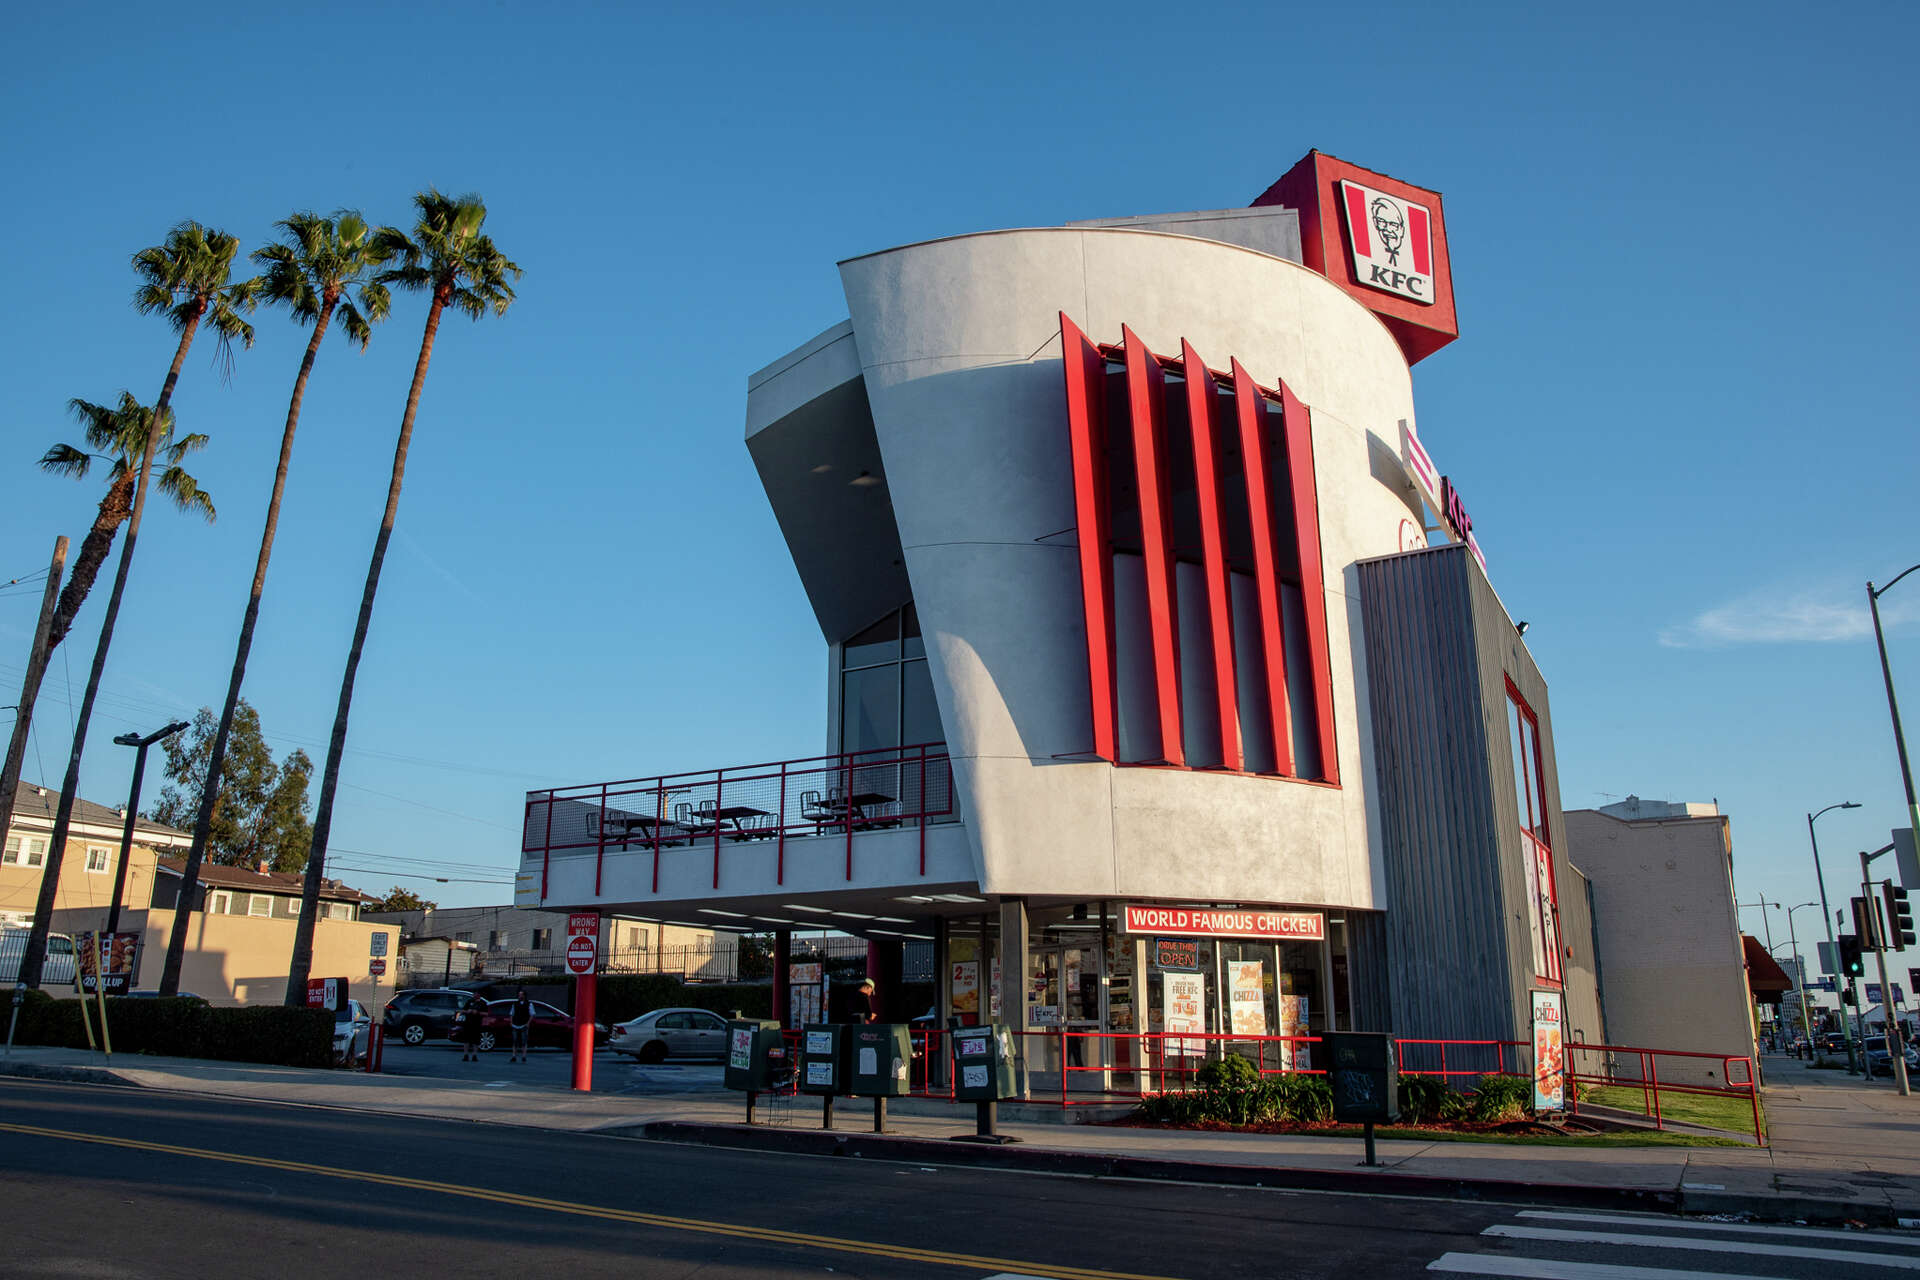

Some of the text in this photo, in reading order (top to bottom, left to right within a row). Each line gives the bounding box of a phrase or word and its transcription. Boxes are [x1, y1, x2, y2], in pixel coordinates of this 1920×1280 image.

[1370, 264, 1423, 296] KFC
[1443, 477, 1474, 553] KFC
[572, 917, 596, 928] WRONG
[1132, 909, 1317, 933] WORLD FAMOUS CHICKEN
[576, 928, 590, 936] WAY
[1160, 952, 1195, 967] OPEN
[1173, 985, 1186, 995] FREE
[1233, 990, 1260, 1002] CHIZZA
[1535, 1007, 1560, 1022] CHIZZA
